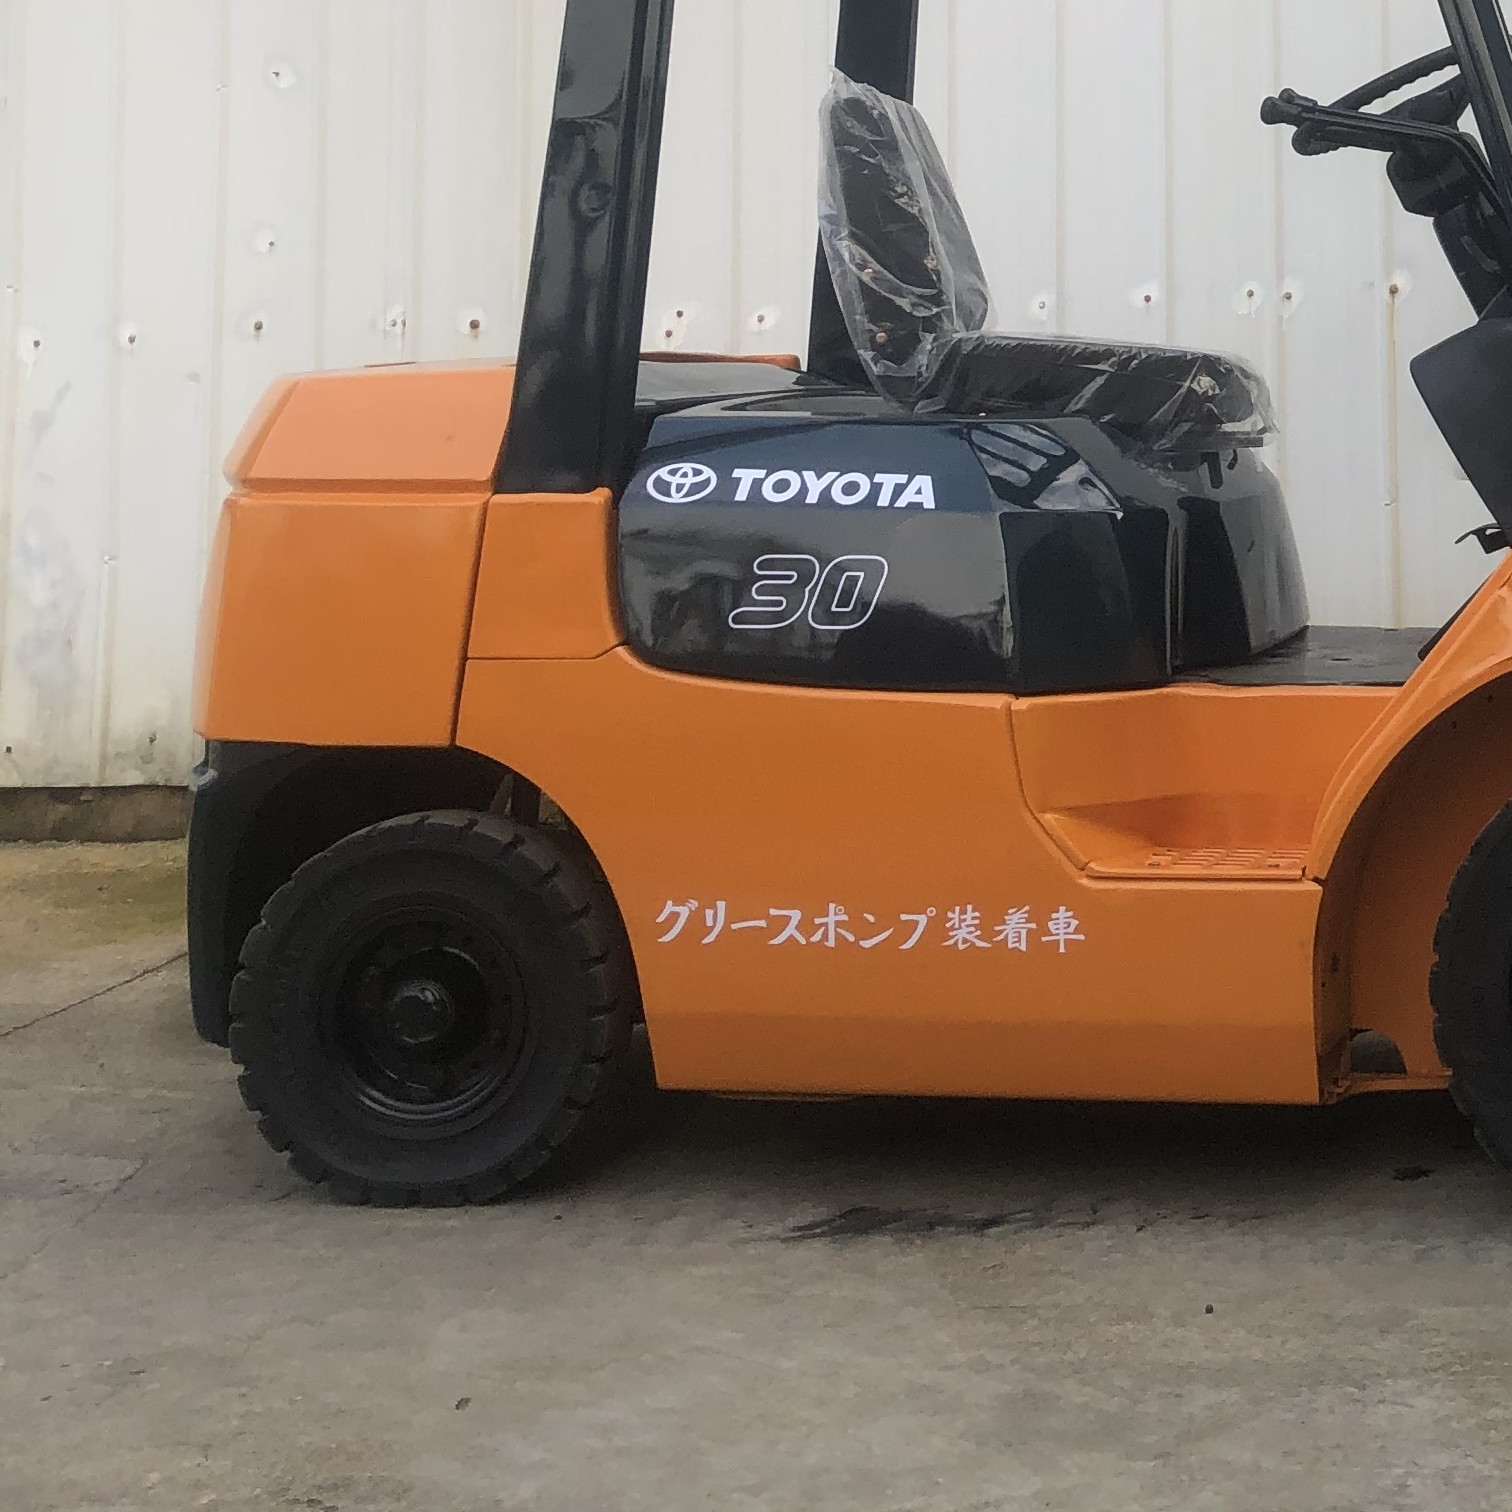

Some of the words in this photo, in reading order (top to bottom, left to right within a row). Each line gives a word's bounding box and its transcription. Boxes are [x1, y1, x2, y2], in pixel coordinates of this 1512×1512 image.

[731, 468, 936, 510] TOYOTA
[728, 554, 889, 630] 30
[655, 899, 1086, 954] グリースポンプ装着車
